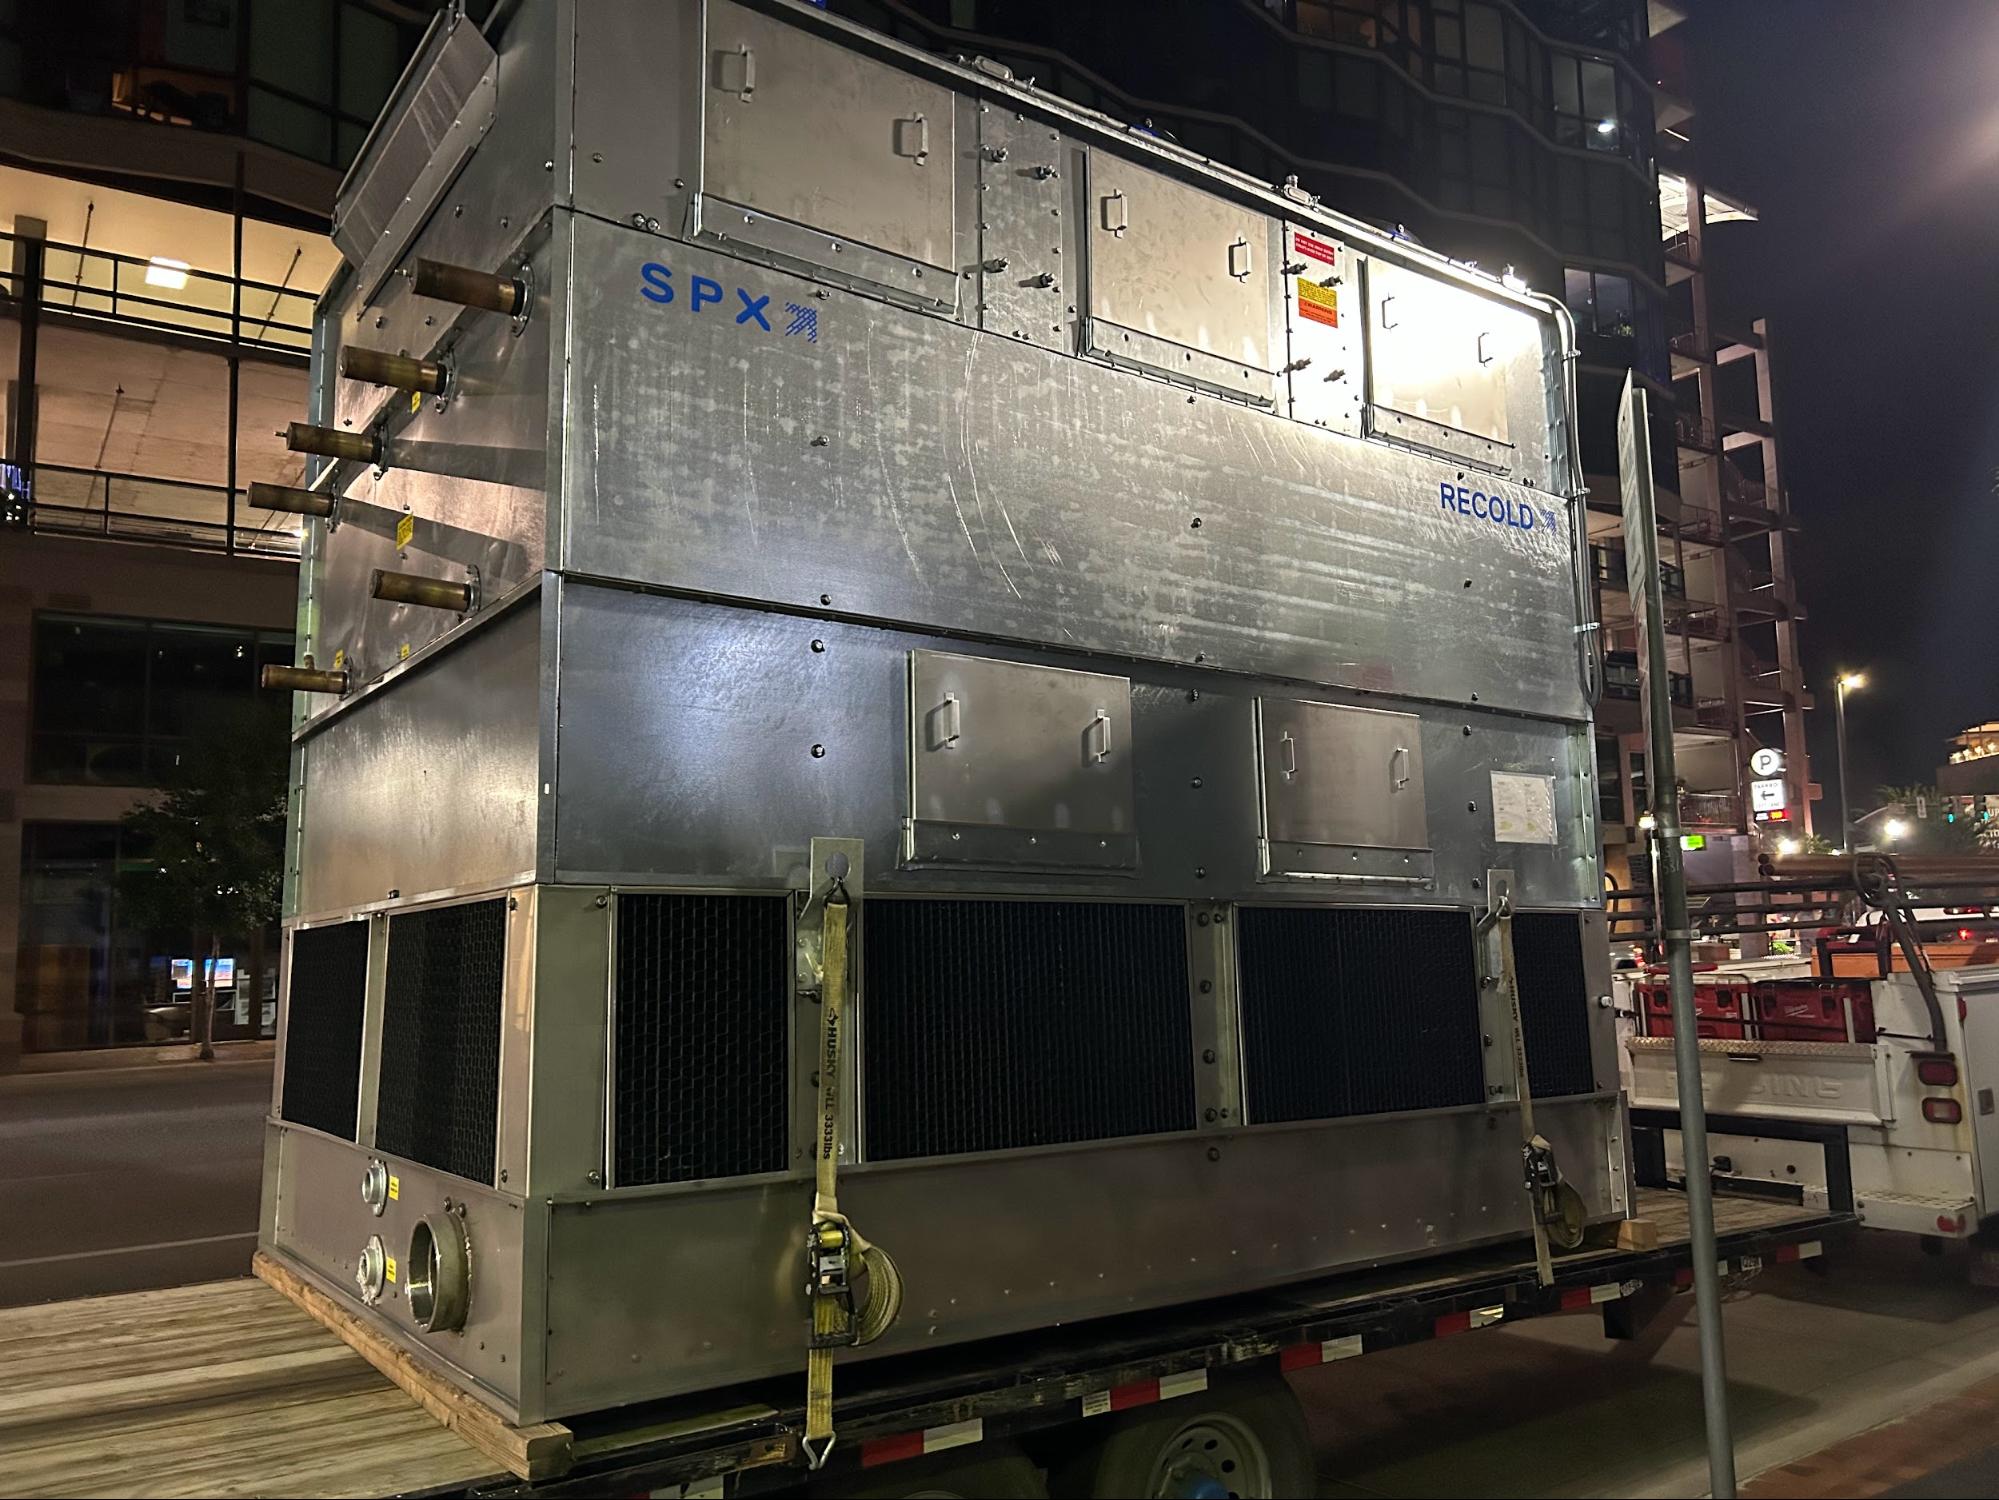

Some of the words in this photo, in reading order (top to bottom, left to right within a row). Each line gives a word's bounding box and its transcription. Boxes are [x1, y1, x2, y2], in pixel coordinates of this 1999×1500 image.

[640, 262, 771, 332] SPX
[1440, 482, 1534, 530] RECOLD
[1760, 755, 1772, 770] P
[826, 1026, 838, 1078] HUSKY
[823, 1114, 834, 1160] 3333lbs
